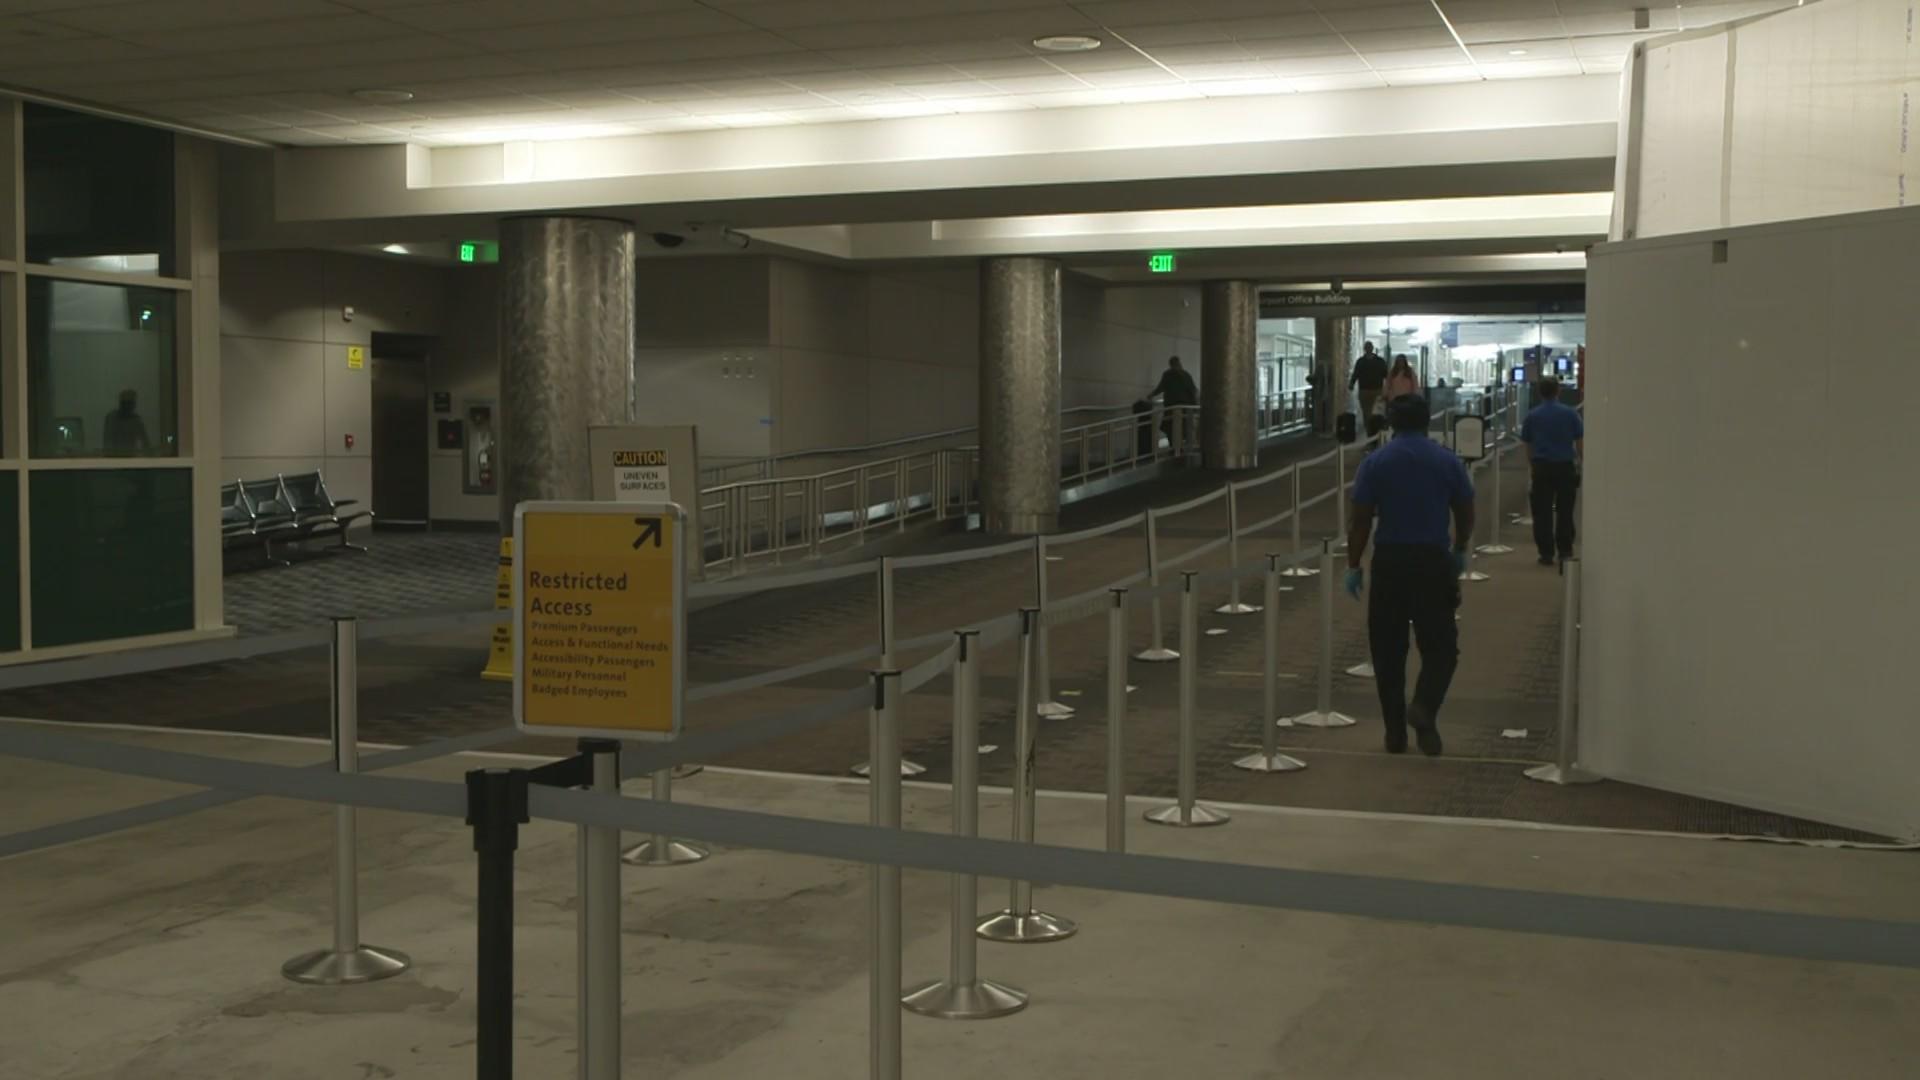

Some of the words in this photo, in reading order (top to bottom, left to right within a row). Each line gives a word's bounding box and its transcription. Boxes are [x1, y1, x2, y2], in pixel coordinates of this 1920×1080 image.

[461, 245, 474, 261] EXIT
[1152, 255, 1173, 272] EXIT
[1287, 295, 1313, 304] Office
[1315, 294, 1352, 305] Building
[614, 451, 666, 465] CAUTION
[623, 471, 659, 481] UNEVEN
[620, 481, 666, 490] SURFACES
[530, 571, 628, 591] Restricted
[530, 596, 593, 616] Access
[532, 620, 578, 632] Premium
[580, 621, 638, 636] Passengers
[532, 636, 565, 648] Access
[567, 637, 576, 648] &
[578, 637, 633, 651] Functional
[636, 640, 669, 652] Needs
[532, 651, 595, 666] Accessibility
[597, 654, 656, 669] Passengers
[532, 667, 572, 681] Military
[575, 669, 627, 682] Personnel
[532, 683, 570, 697] Badged
[572, 685, 628, 700] Employees
